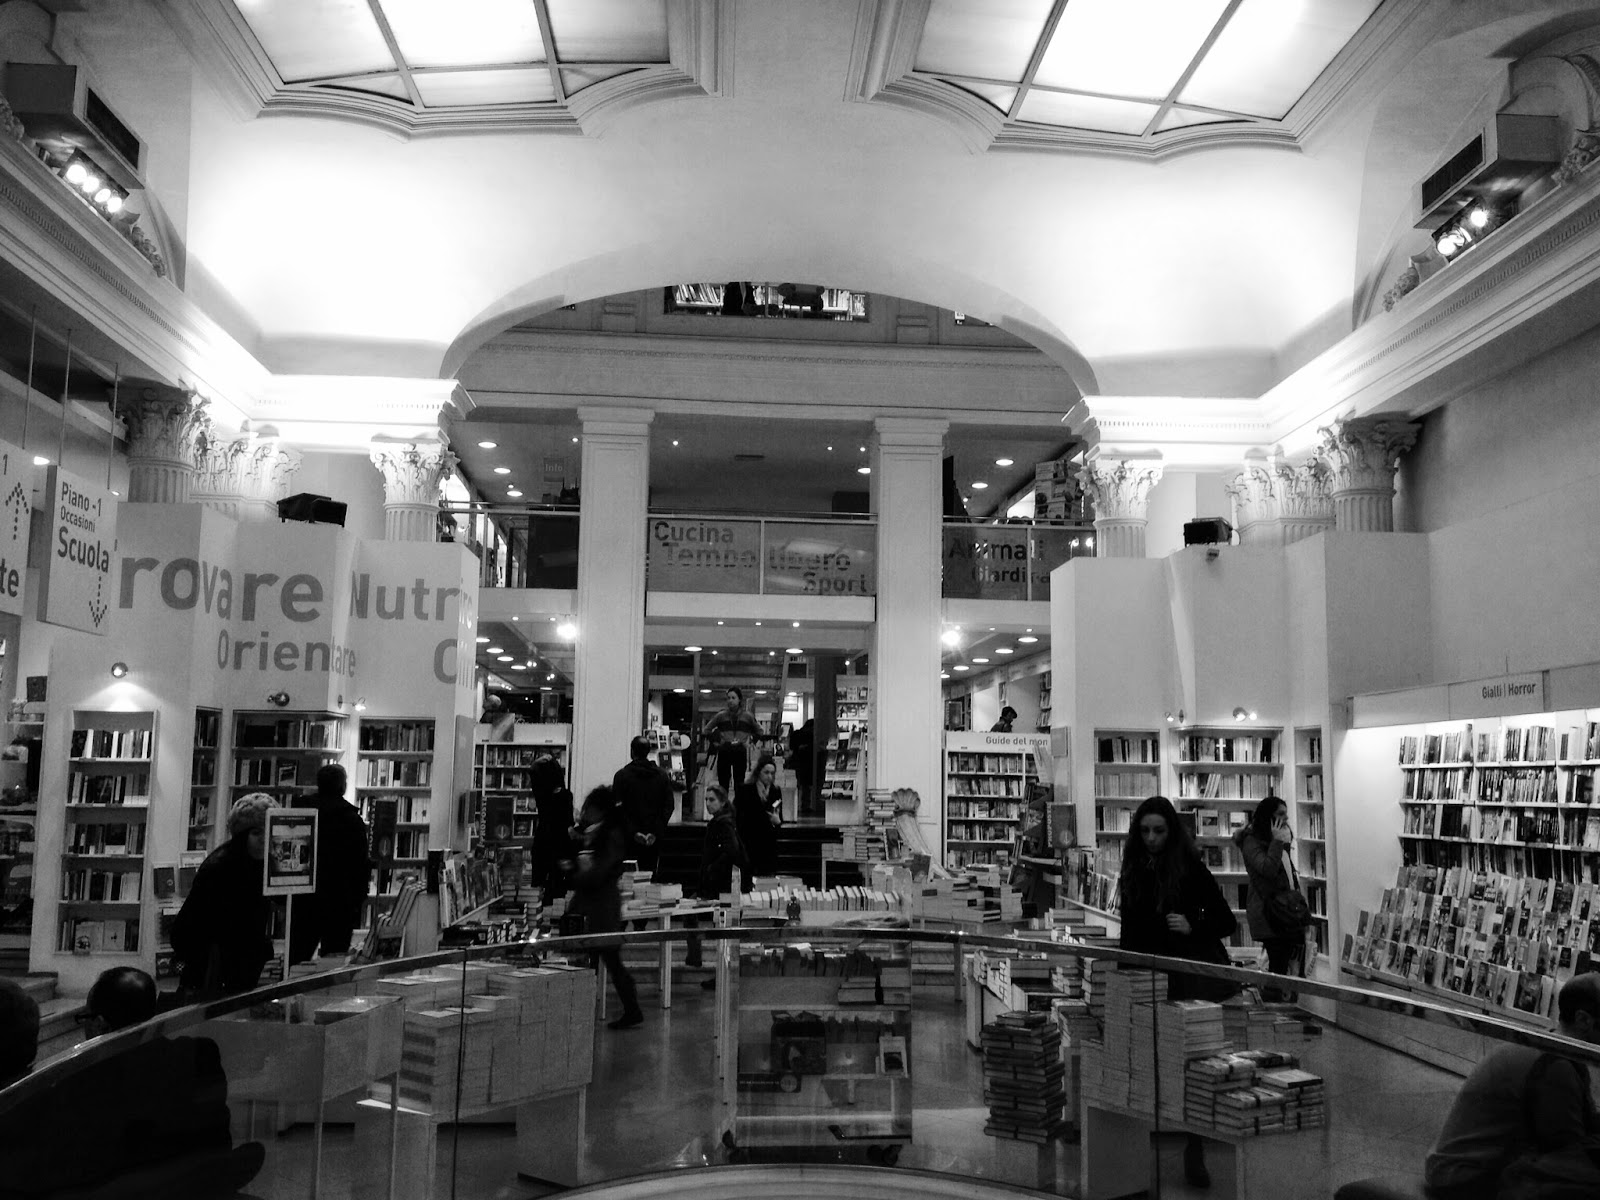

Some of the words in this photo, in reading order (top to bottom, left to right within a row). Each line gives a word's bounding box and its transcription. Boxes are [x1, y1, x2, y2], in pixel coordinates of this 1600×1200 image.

[61, 481, 90, 512] Piano
[60, 505, 96, 533] Occasioni
[654, 521, 734, 543] Cucina
[57, 526, 109, 573] Scuola
[116, 548, 324, 623] rovare
[217, 629, 356, 678] Orientare
[1482, 685, 1501, 699] Gialli
[1508, 683, 1536, 695] Horror
[985, 735, 1010, 745] Guide
[1013, 737, 1027, 745] del
